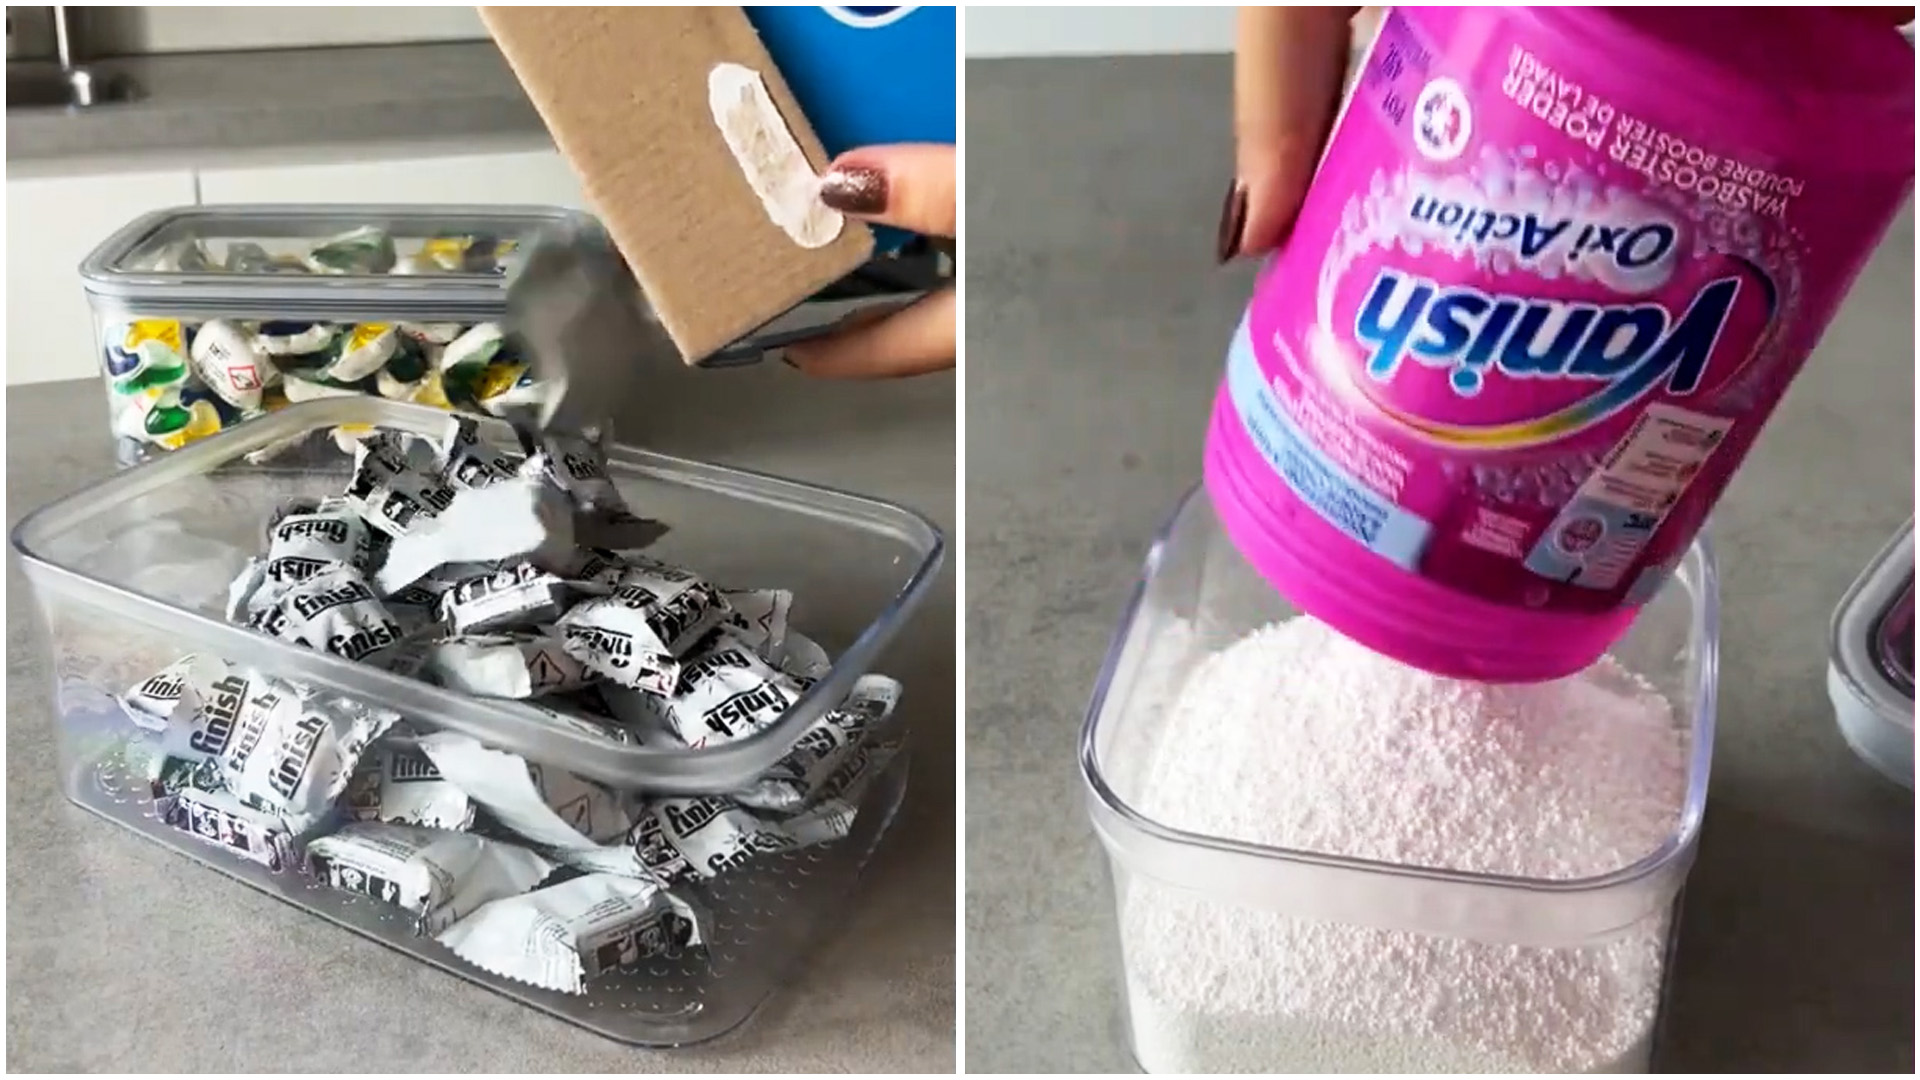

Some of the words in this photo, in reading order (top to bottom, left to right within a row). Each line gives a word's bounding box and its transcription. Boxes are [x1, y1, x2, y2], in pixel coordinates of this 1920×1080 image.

[1502, 71, 1607, 152] POEDER
[1585, 94, 1615, 124] DE
[1617, 113, 1719, 172] BOOSTER
[1609, 135, 1788, 218] WASBOOSTER
[1721, 158, 1805, 198] POUDRE
[1410, 195, 1572, 259] Action
[1567, 222, 1676, 268] Oxi
[1354, 267, 1742, 395] Vanish
[278, 518, 349, 545] finish
[294, 580, 375, 622] finish
[328, 618, 403, 662] finish
[670, 650, 751, 698] finish
[190, 675, 249, 756] finish
[705, 680, 790, 738] finish
[268, 716, 329, 800] finish
